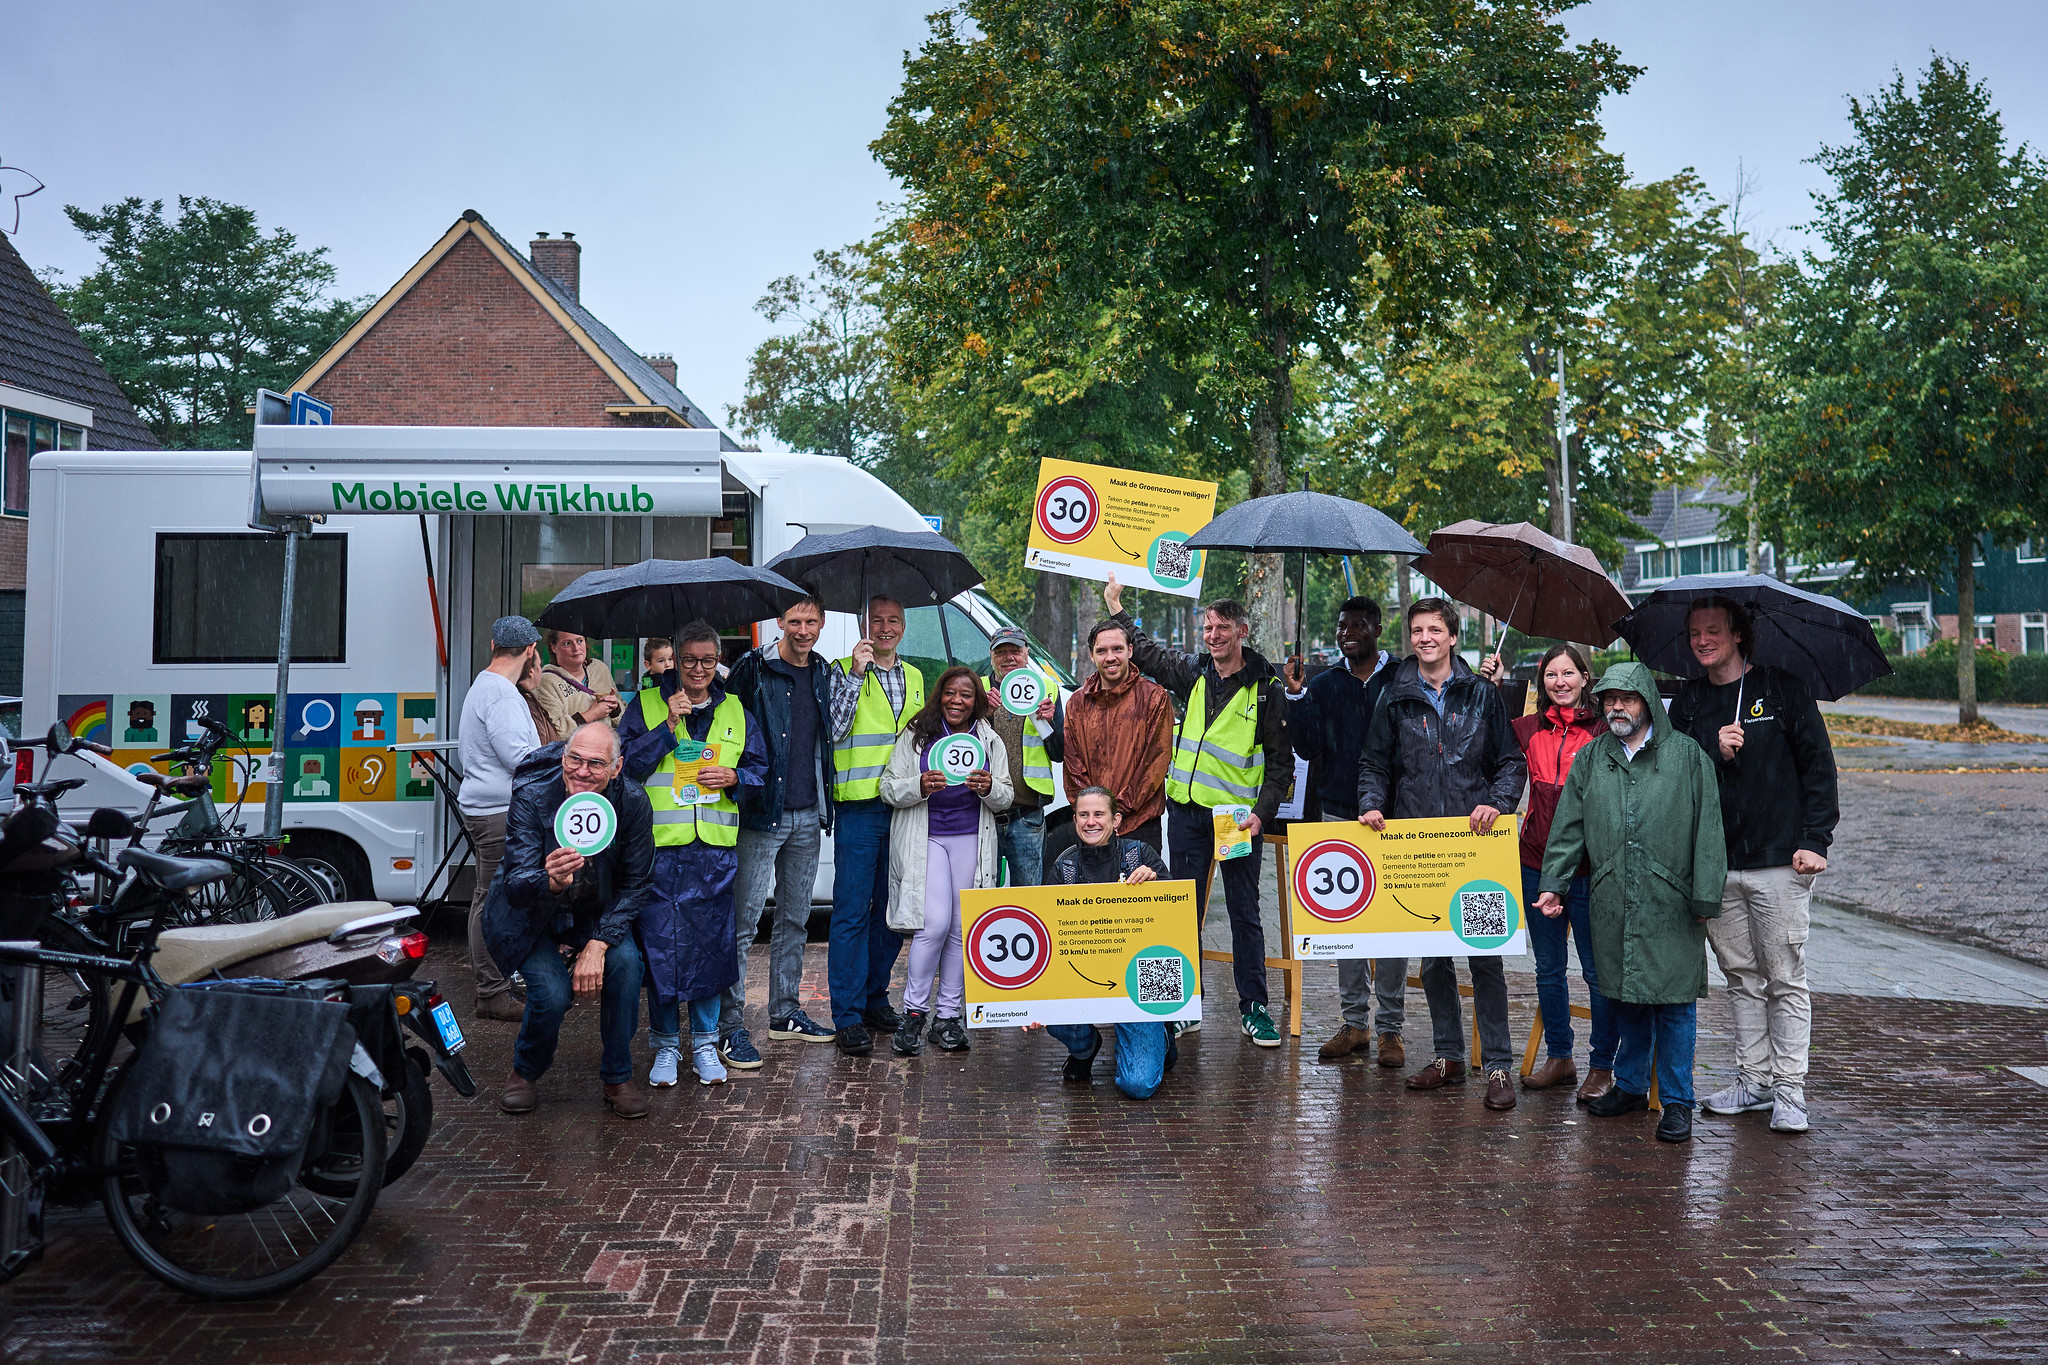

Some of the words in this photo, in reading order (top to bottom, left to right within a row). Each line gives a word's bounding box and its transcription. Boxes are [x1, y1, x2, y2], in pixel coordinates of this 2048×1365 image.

[1110, 478, 1127, 487] Maak
[1139, 483, 1182, 495] Groenezoom
[1182, 490, 1210, 500] veiliger!
[332, 482, 487, 511] Mobiele
[494, 483, 654, 515] Wijkhub
[1050, 498, 1086, 523] 30
[1106, 504, 1132, 512] Gemeente
[1133, 508, 1160, 517] Rotterdam
[1157, 504, 1172, 512] vraag
[1112, 513, 1144, 523] Groenezoom
[1040, 558, 1070, 567] Fietsersbond
[948, 749, 974, 767] 30
[569, 813, 601, 835] 30
[1418, 830, 1473, 839] Groenezoom
[1413, 852, 1436, 860] petitie
[1313, 866, 1359, 895] 30
[1056, 898, 1081, 906] Maak
[1095, 895, 1152, 904] Groenezoom
[1153, 893, 1189, 903] veiliger!
[1090, 917, 1113, 926] petitie
[986, 932, 1034, 963] 30
[438, 1007, 451, 1025] DLP
